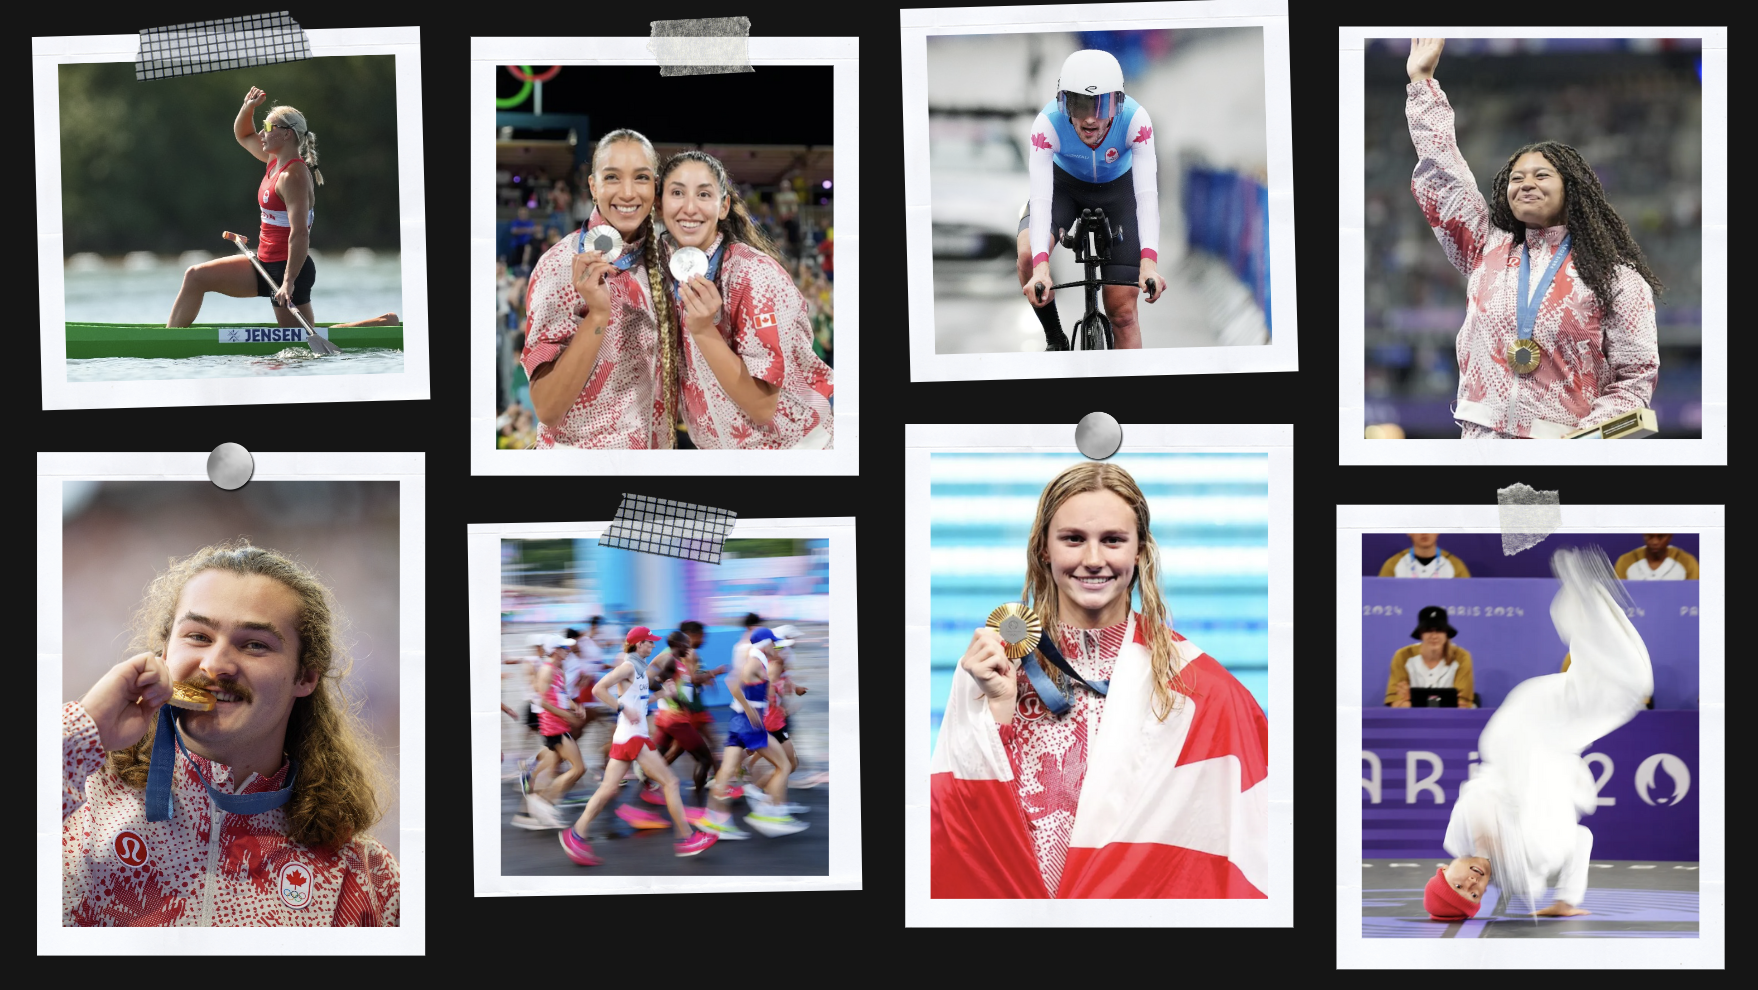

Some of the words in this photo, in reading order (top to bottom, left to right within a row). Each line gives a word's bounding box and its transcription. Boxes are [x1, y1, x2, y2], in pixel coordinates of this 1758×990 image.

[244, 328, 302, 342] JENSEN
[1362, 605, 1403, 616] 2024
[1445, 605, 1481, 617] ARIS
[1484, 606, 1525, 618] 2024
[1625, 607, 1646, 618] 24
